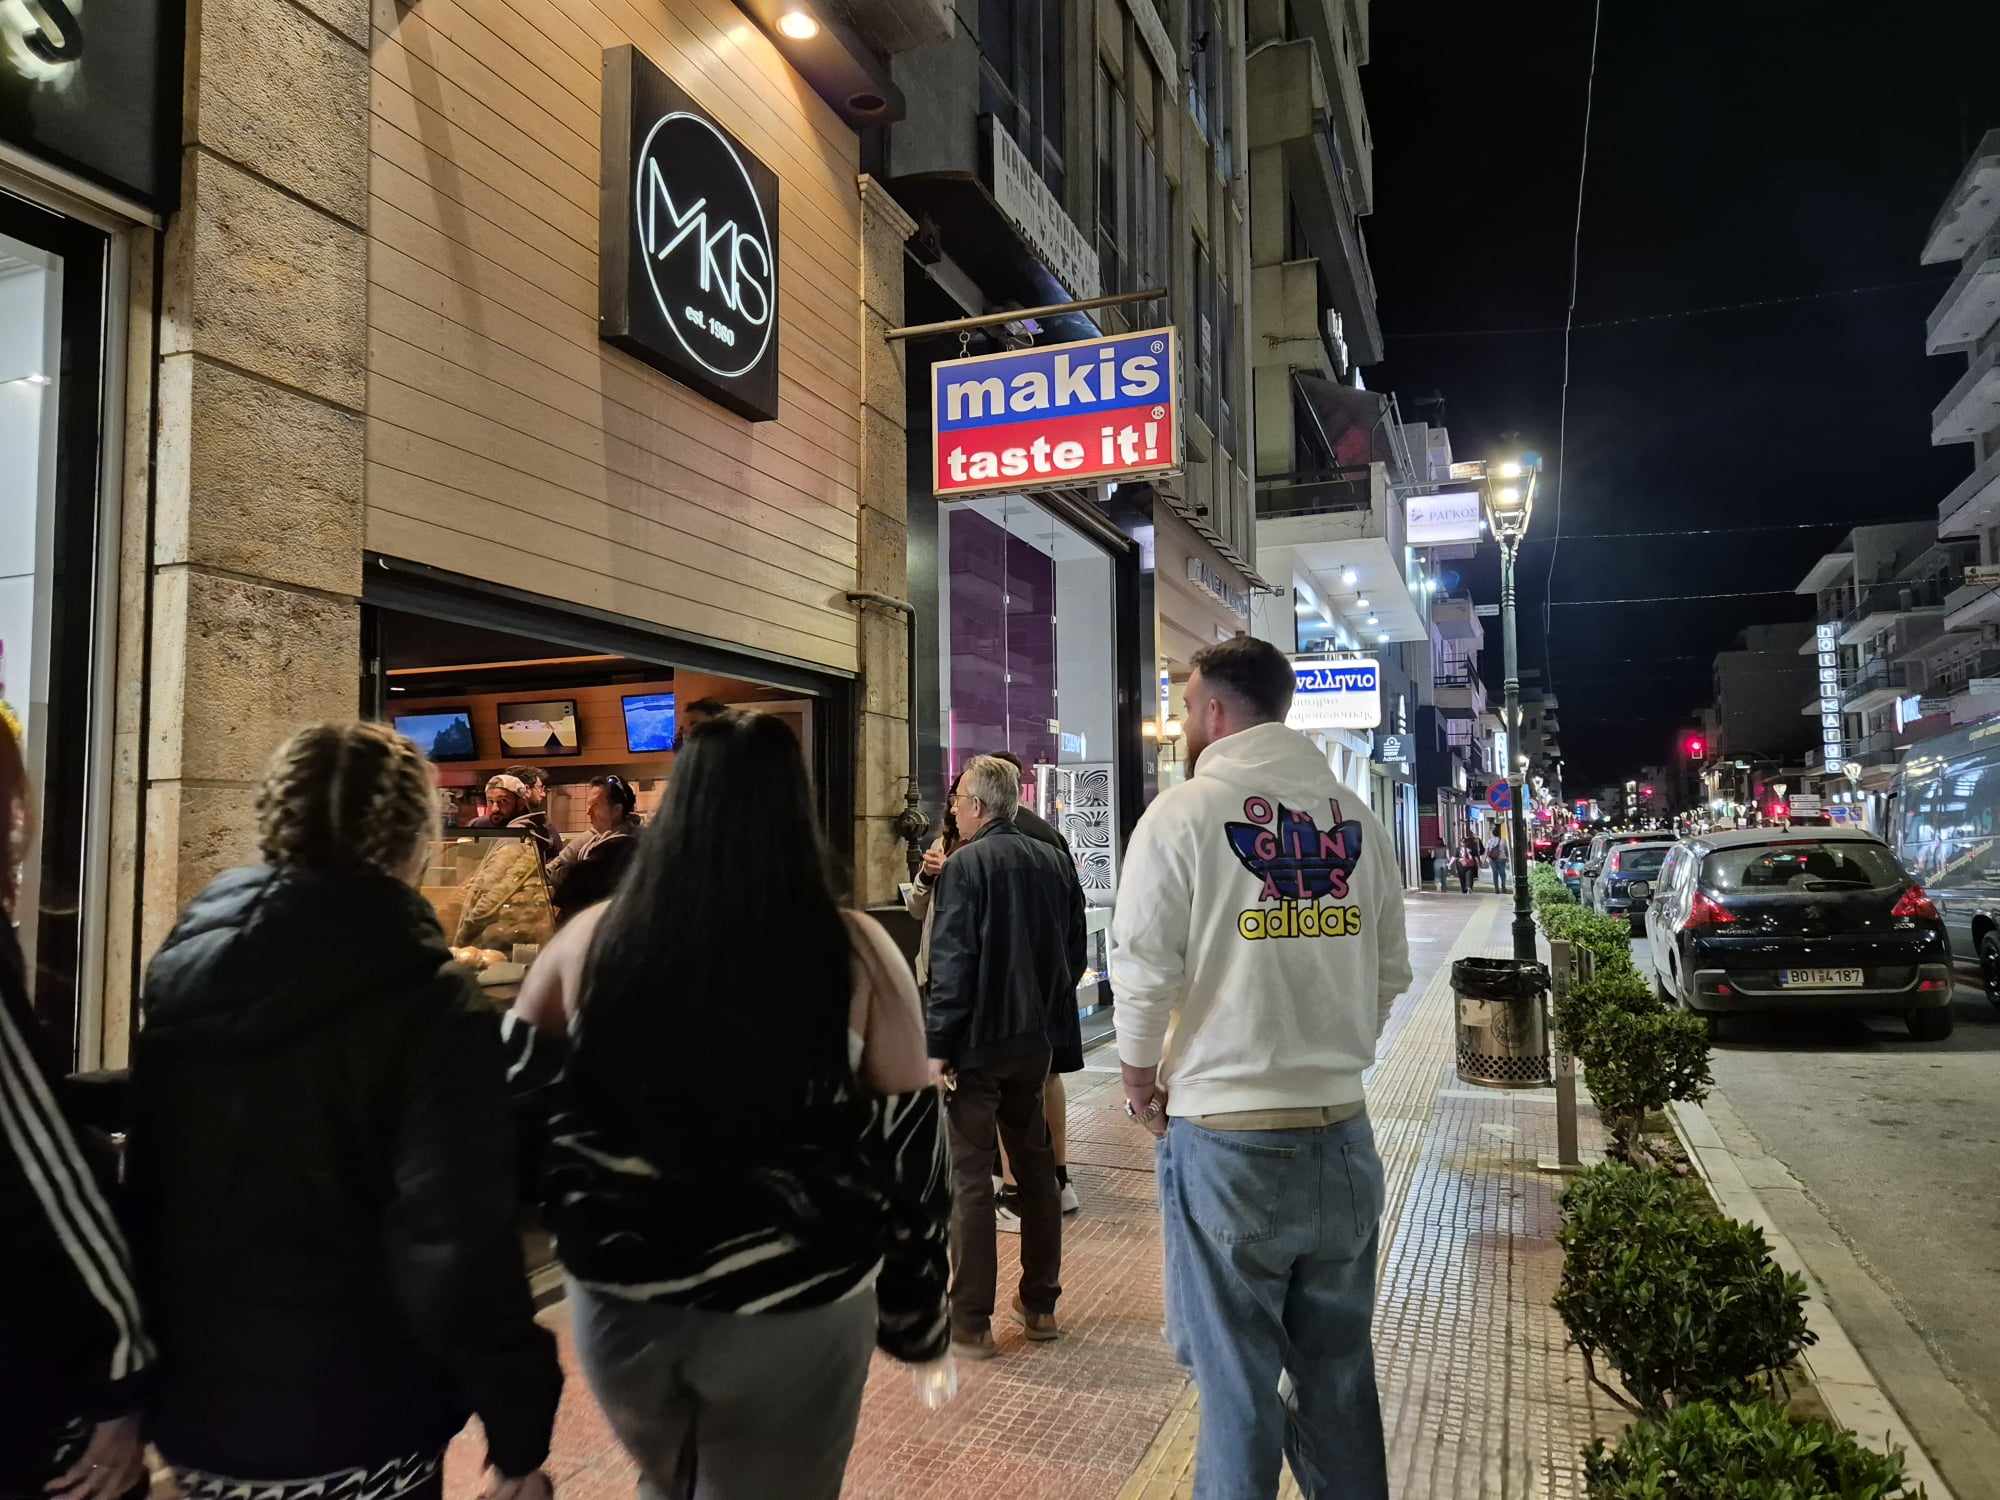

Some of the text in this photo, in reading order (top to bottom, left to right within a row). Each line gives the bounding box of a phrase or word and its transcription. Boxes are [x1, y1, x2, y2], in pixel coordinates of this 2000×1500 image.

[685, 305, 706, 329] est.
[947, 421, 1158, 482] taste it!
[1296, 670, 1375, 693] νελληνιο
[1238, 897, 1362, 941] adidas
